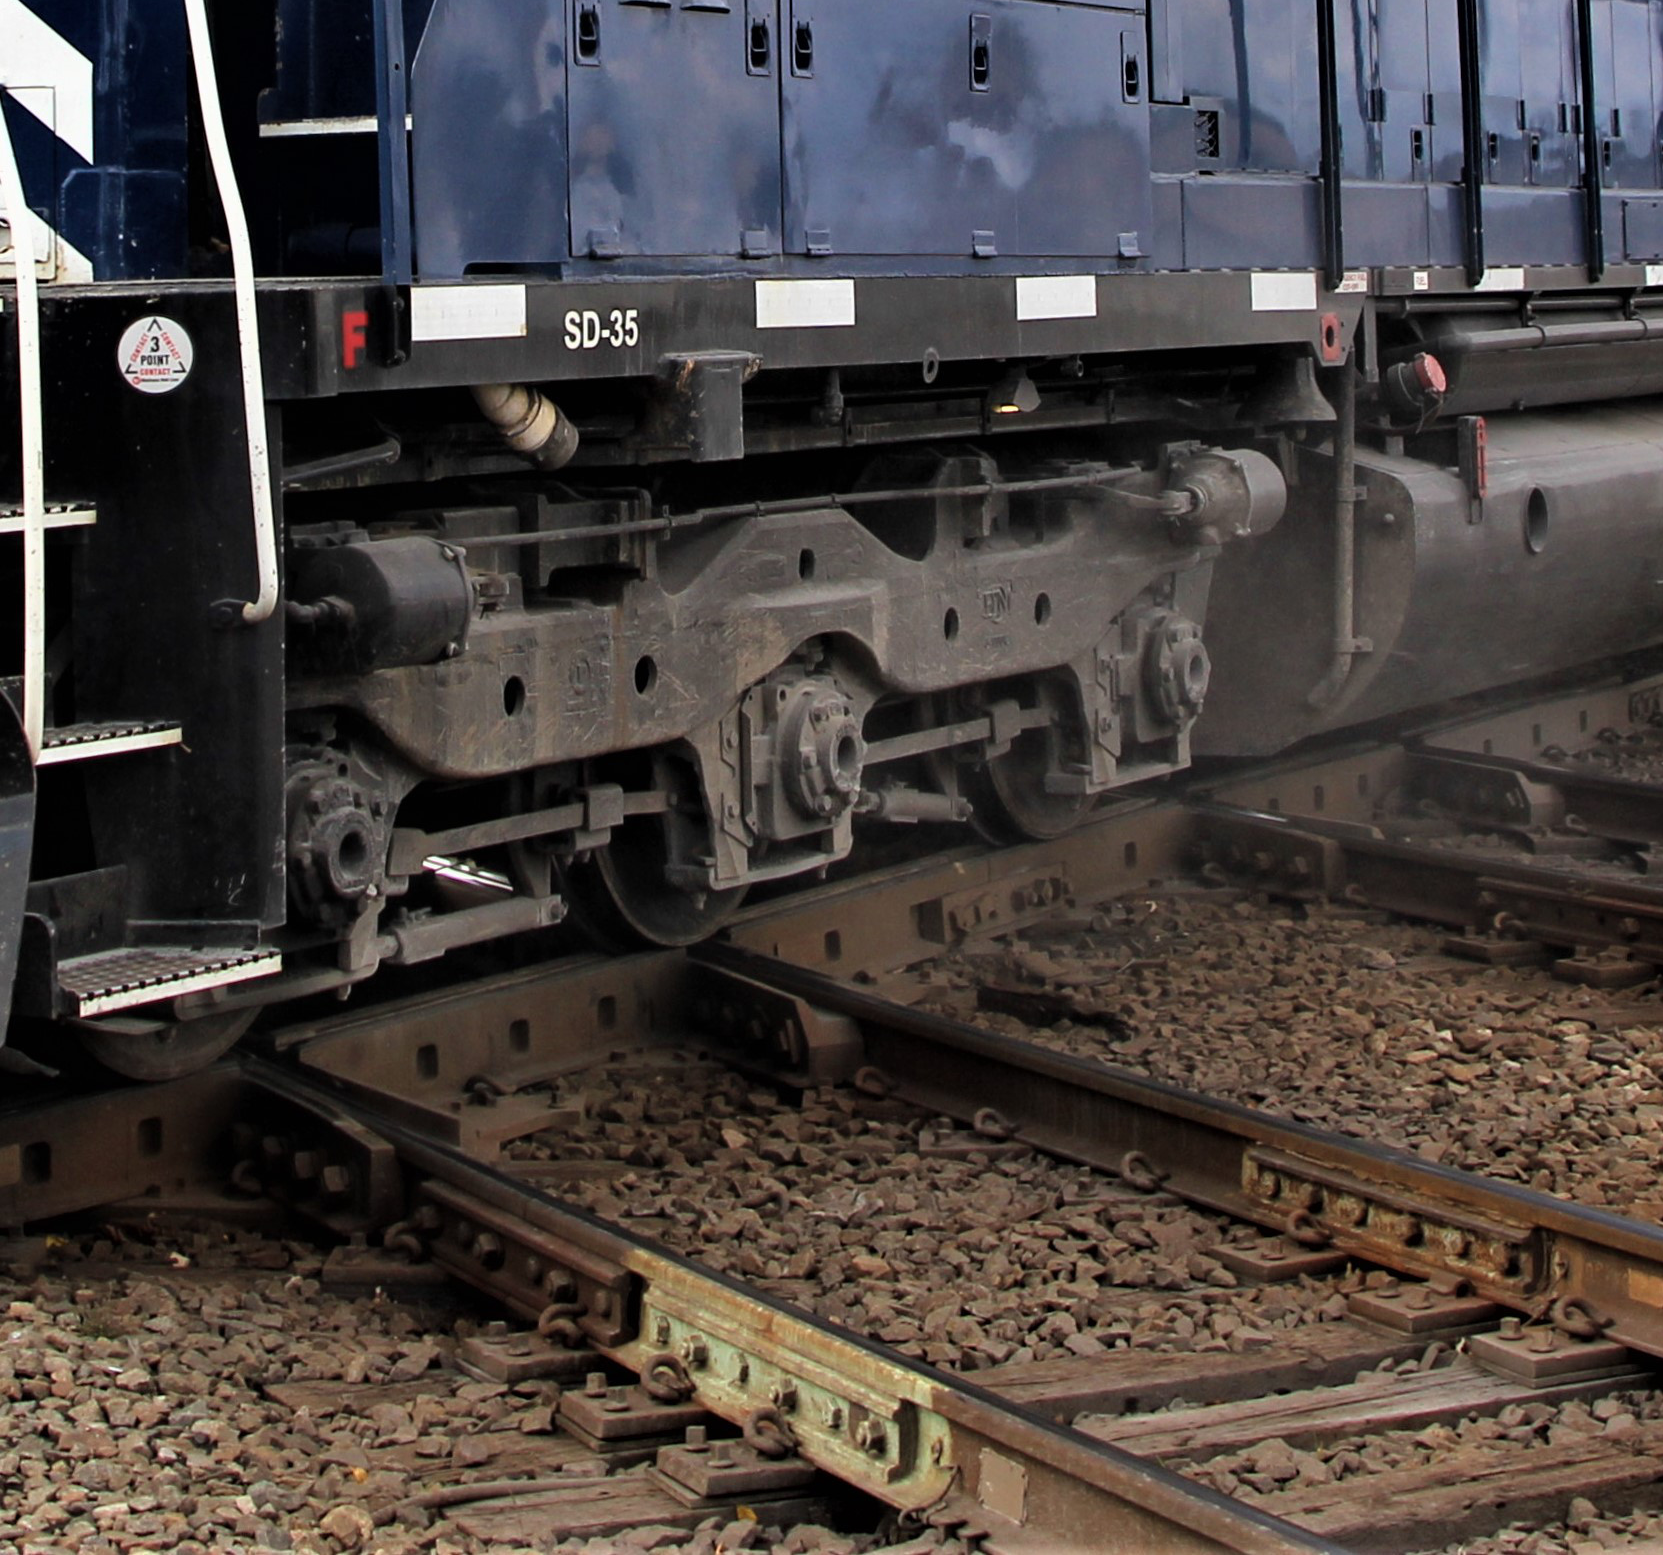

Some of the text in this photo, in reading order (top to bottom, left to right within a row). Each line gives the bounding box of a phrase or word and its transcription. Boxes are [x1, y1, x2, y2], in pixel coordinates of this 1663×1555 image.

[150, 336, 160, 353] 3
[342, 311, 368, 370] F
[564, 310, 639, 350] SD-35
[130, 332, 149, 363] CONTACT
[140, 354, 170, 366] POINT
[160, 332, 181, 361] CONTACT
[139, 368, 171, 376] CONTACT
